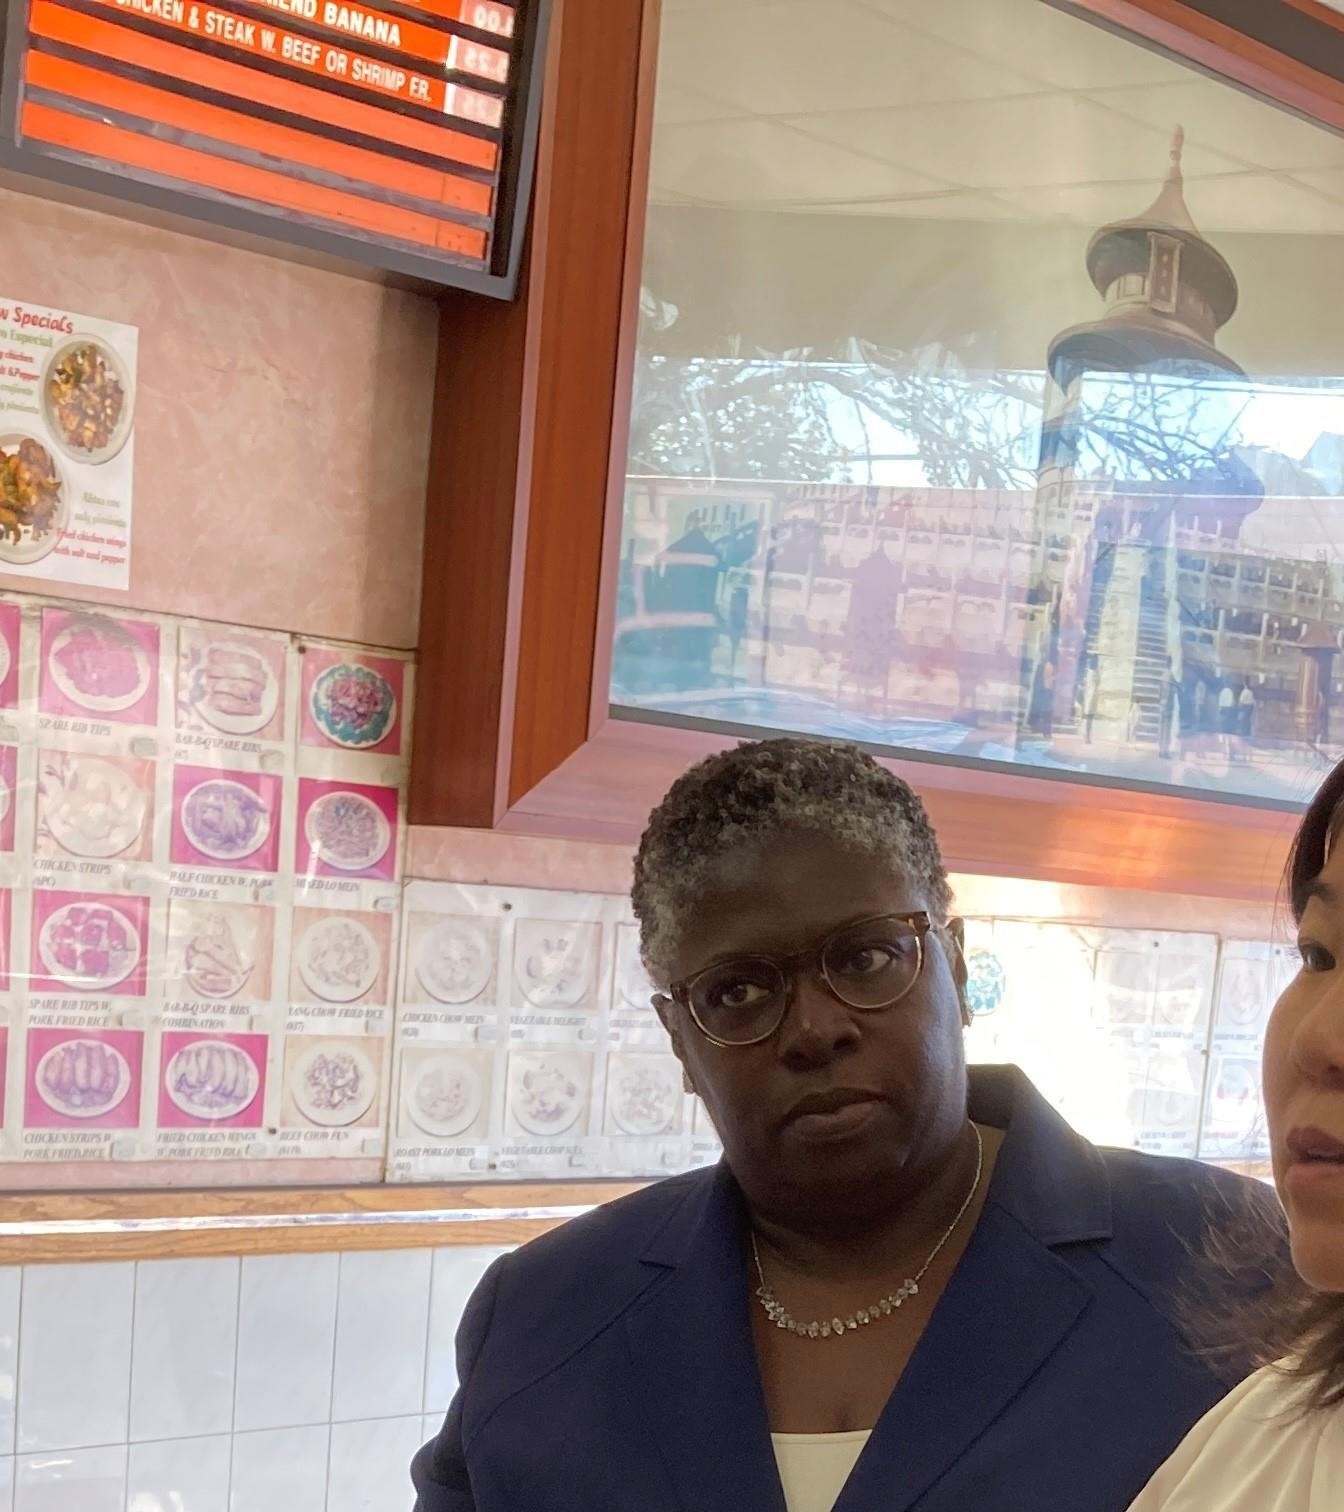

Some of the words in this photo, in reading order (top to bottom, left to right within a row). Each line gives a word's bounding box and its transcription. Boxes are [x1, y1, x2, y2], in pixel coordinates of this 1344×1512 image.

[324, 2, 401, 46] BANANA
[116, 0, 184, 23] CKEN
[188, 6, 200, 29] &
[205, 11, 256, 46] STEAK
[261, 29, 276, 53] W.
[282, 37, 321, 66] BEEF
[325, 50, 348, 75] OR
[352, 58, 406, 92] SHRIMP
[13, 306, 73, 334] Specials
[38, 718, 70, 732] SPARE
[90, 724, 111, 736] TIPS
[33, 859, 76, 873] CHICKEN
[78, 862, 113, 875] STRIPS
[295, 878, 324, 890] MIED
[29, 1000, 61, 1010] SPARE
[79, 1000, 100, 1011] TIPS
[28, 1015, 55, 1026] PORK
[56, 1015, 86, 1026] FRIED
[24, 1133, 69, 1144] CHICKEN
[70, 1133, 103, 1143] STRIPS
